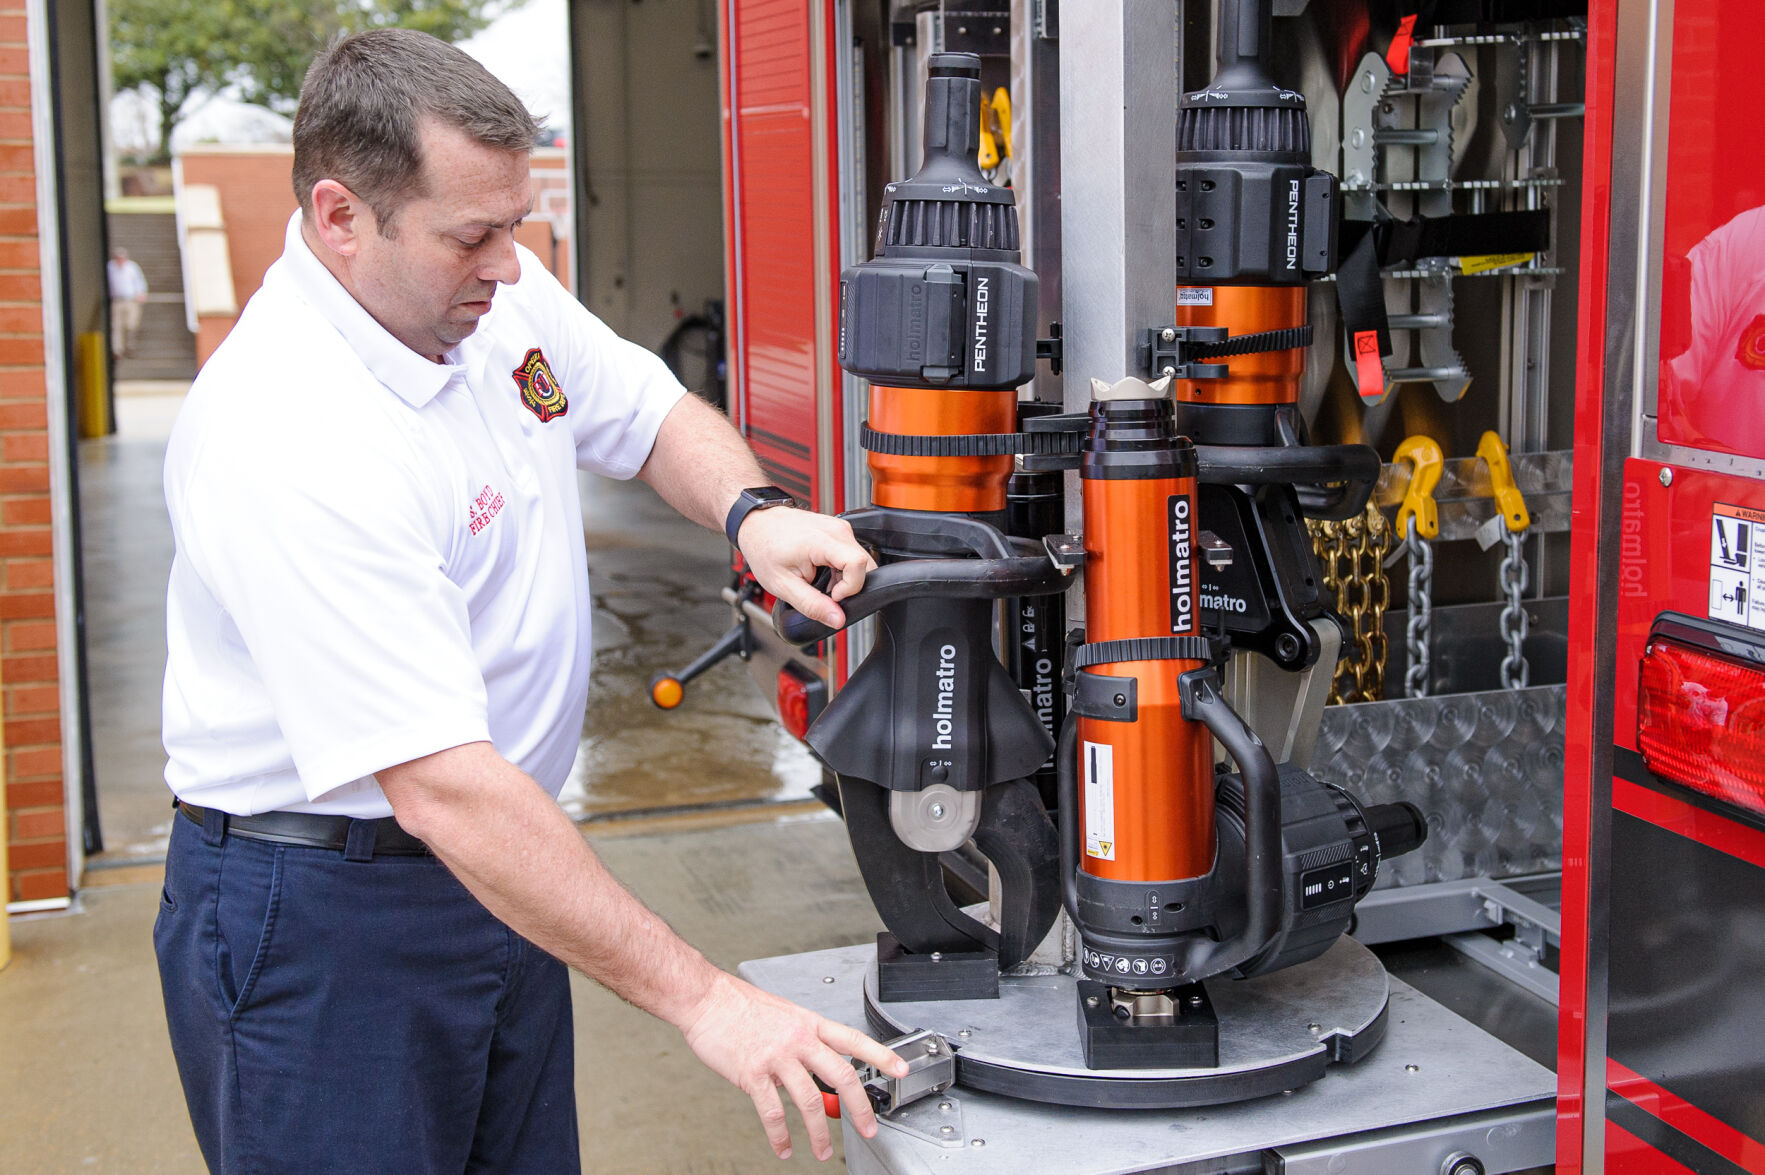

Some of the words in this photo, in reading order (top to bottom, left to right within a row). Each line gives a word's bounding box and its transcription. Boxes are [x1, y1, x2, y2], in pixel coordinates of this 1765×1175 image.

[1286, 179, 1299, 270] PENTHEON
[906, 283, 922, 362] holmatro
[974, 277, 989, 372] PENTHEON
[469, 512, 490, 536] FIRE
[1172, 500, 1192, 632] holmatro
[1200, 594, 1247, 613] matro
[931, 644, 956, 749] holmatro
